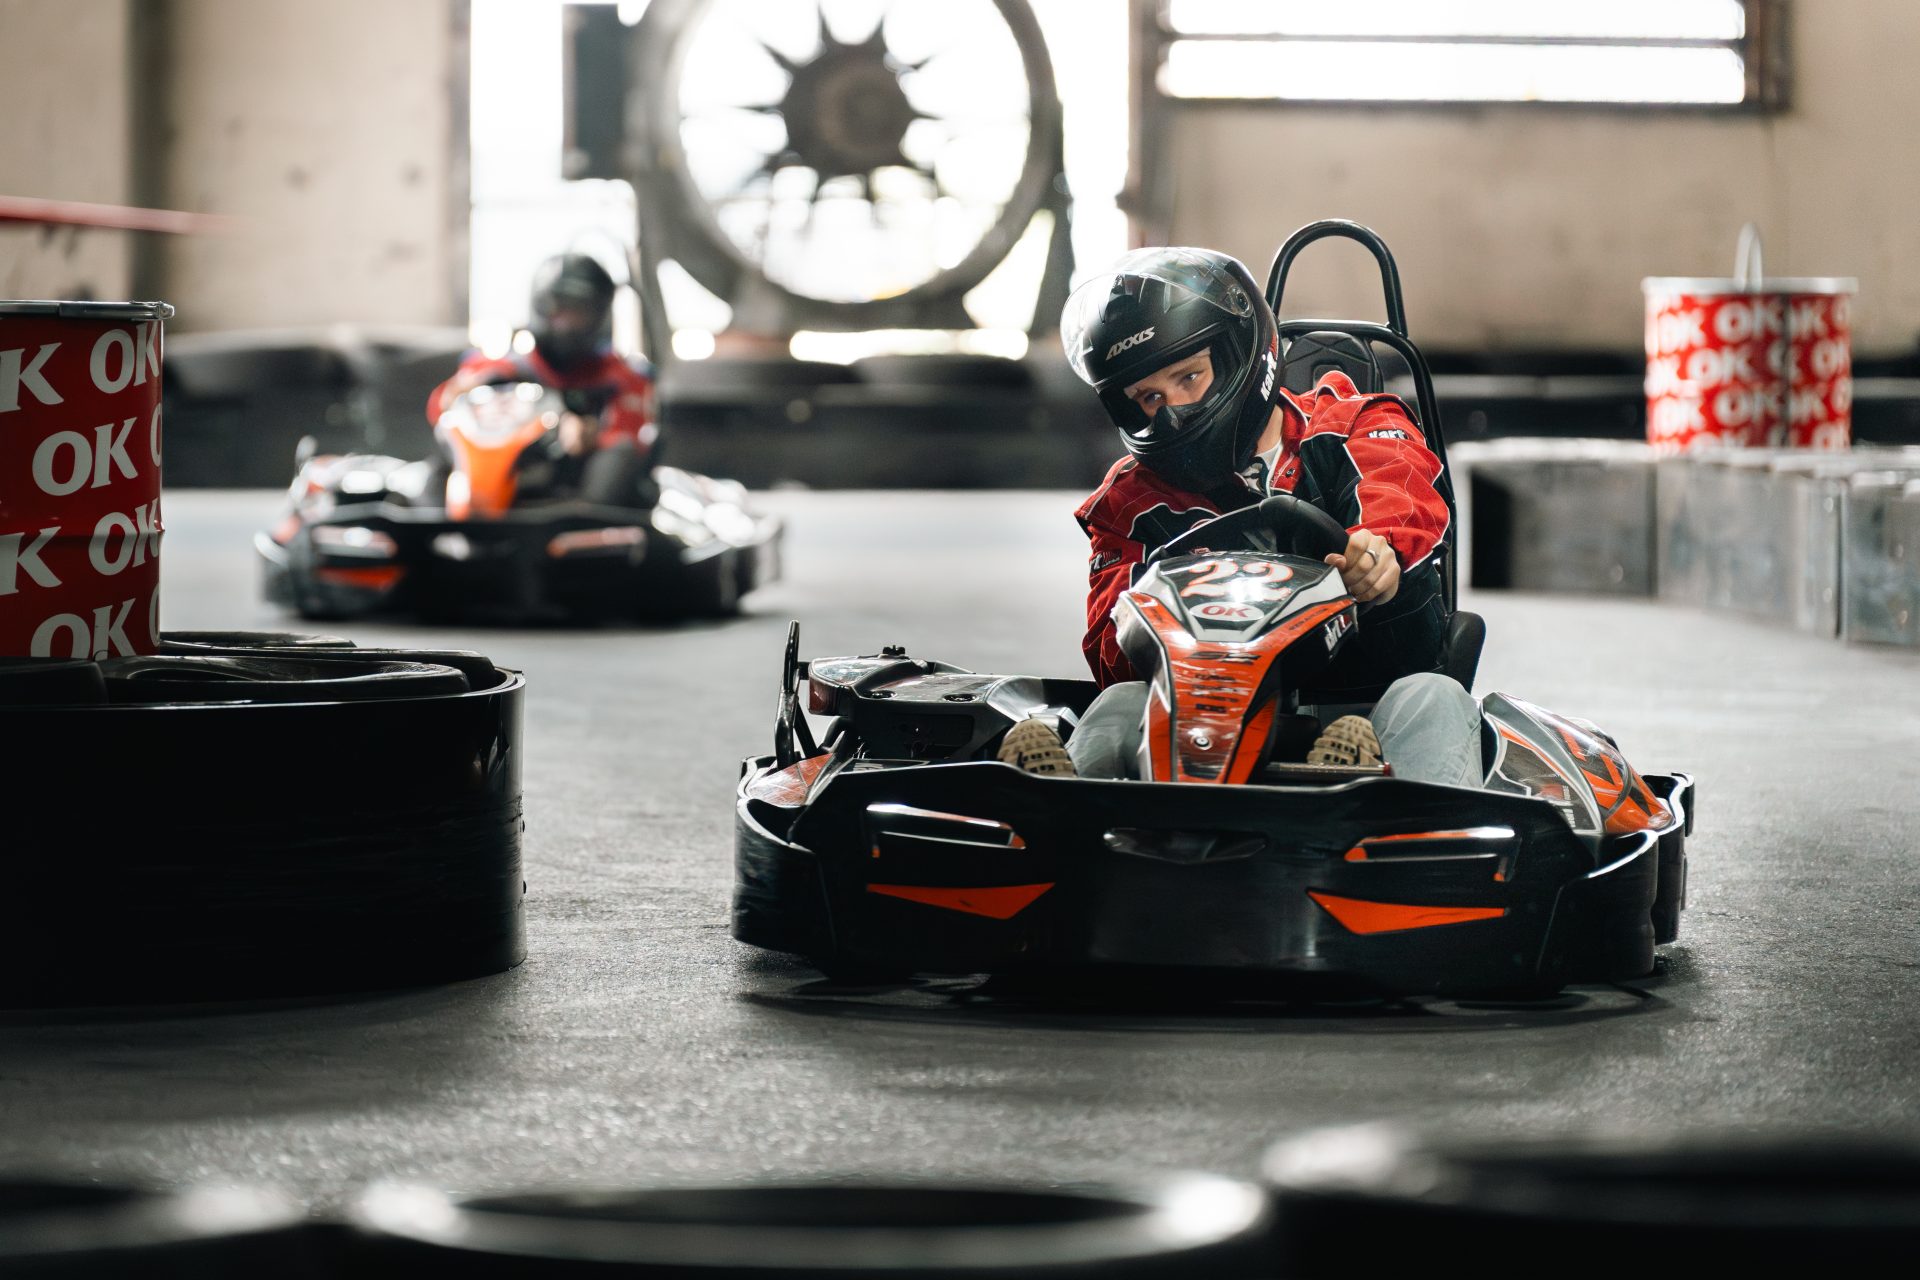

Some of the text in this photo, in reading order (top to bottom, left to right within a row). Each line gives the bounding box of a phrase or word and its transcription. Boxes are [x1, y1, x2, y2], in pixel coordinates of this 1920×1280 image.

[1106, 326, 1155, 361] AXXIS
[1714, 301, 1782, 343] OK
[89, 321, 160, 394] OK
[1686, 345, 1753, 389] OK
[1713, 384, 1782, 427] OK
[32, 417, 139, 496] OK
[88, 497, 161, 576] OK
[1180, 558, 1294, 601] 22
[30, 597, 138, 662] OK
[1201, 604, 1250, 619] OK
